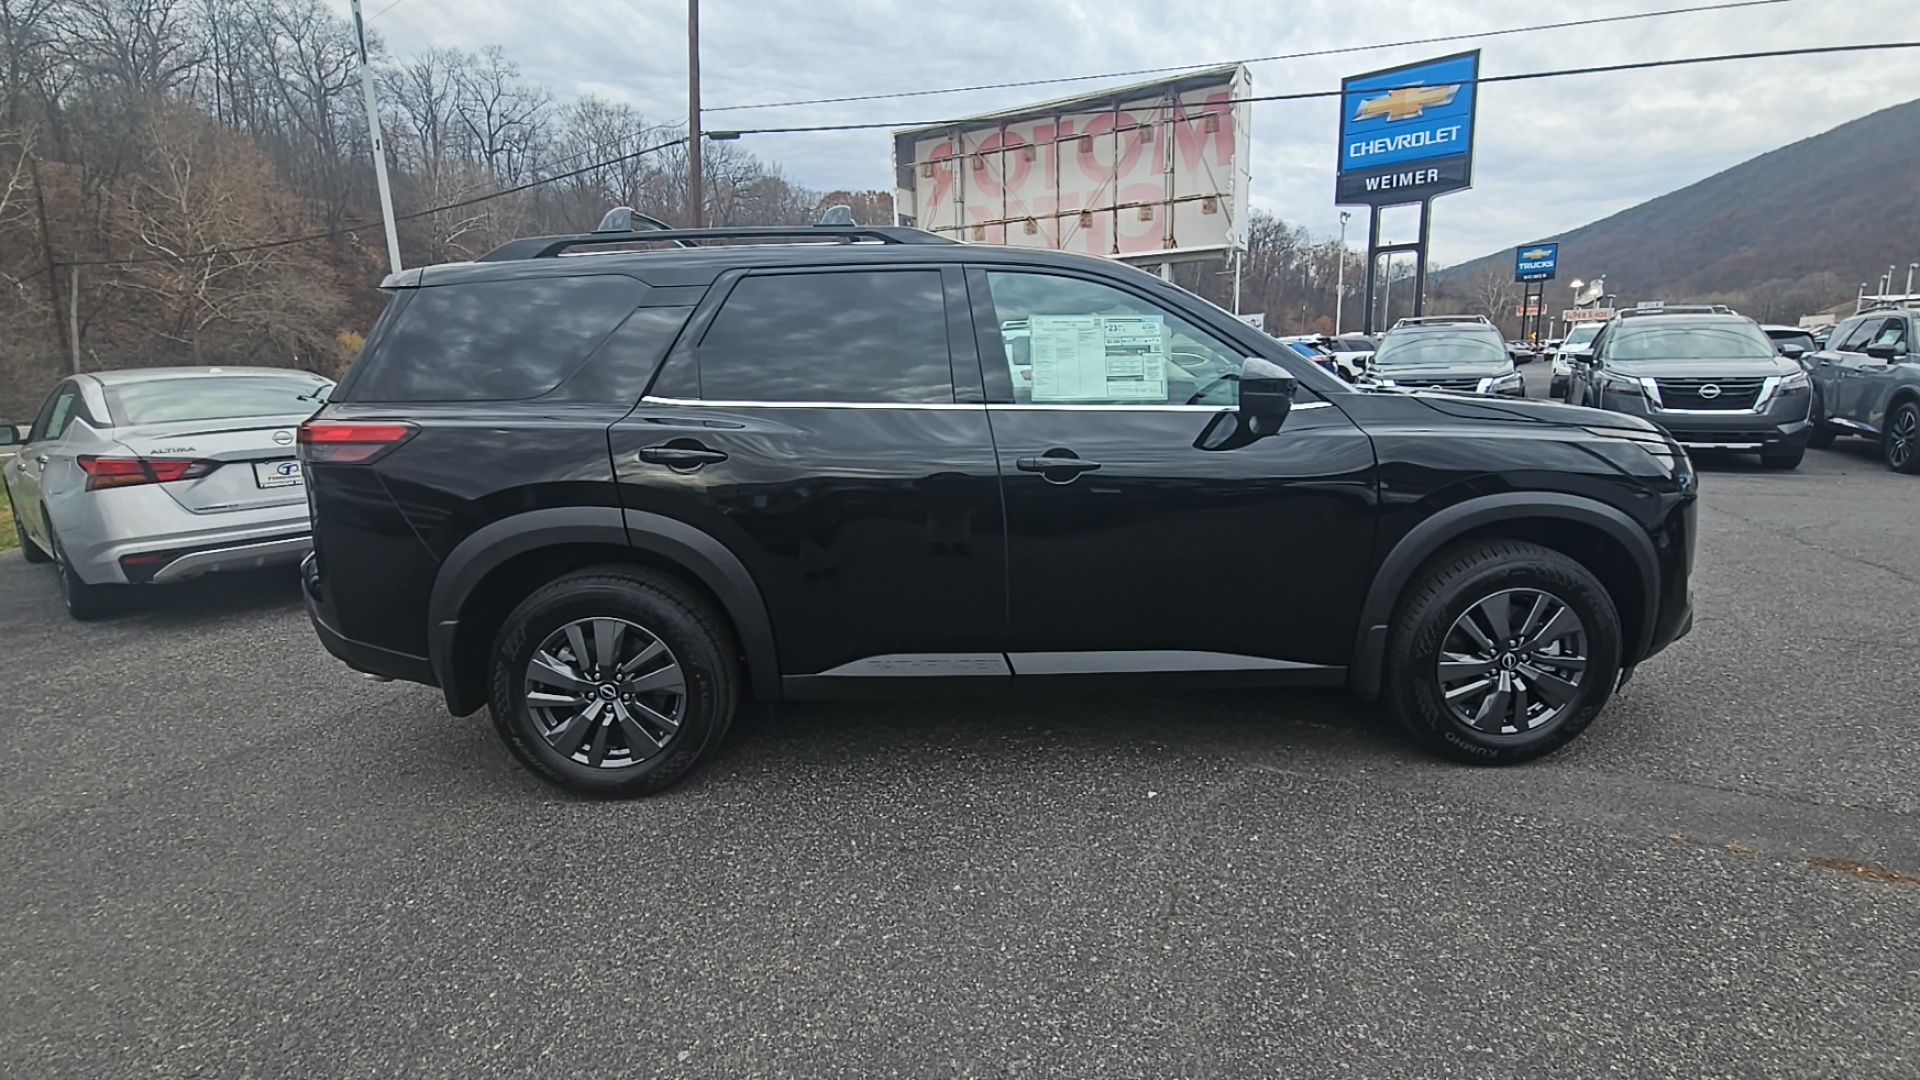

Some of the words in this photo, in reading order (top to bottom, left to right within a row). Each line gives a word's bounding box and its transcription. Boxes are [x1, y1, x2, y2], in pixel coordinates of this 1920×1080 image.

[1350, 125, 1461, 157] CHEVROLET
[1365, 168, 1439, 191] WEIMER
[1519, 260, 1554, 269] TRUCKS
[150, 446, 197, 455] ALTIMA
[1444, 731, 1499, 758] KUMHO
